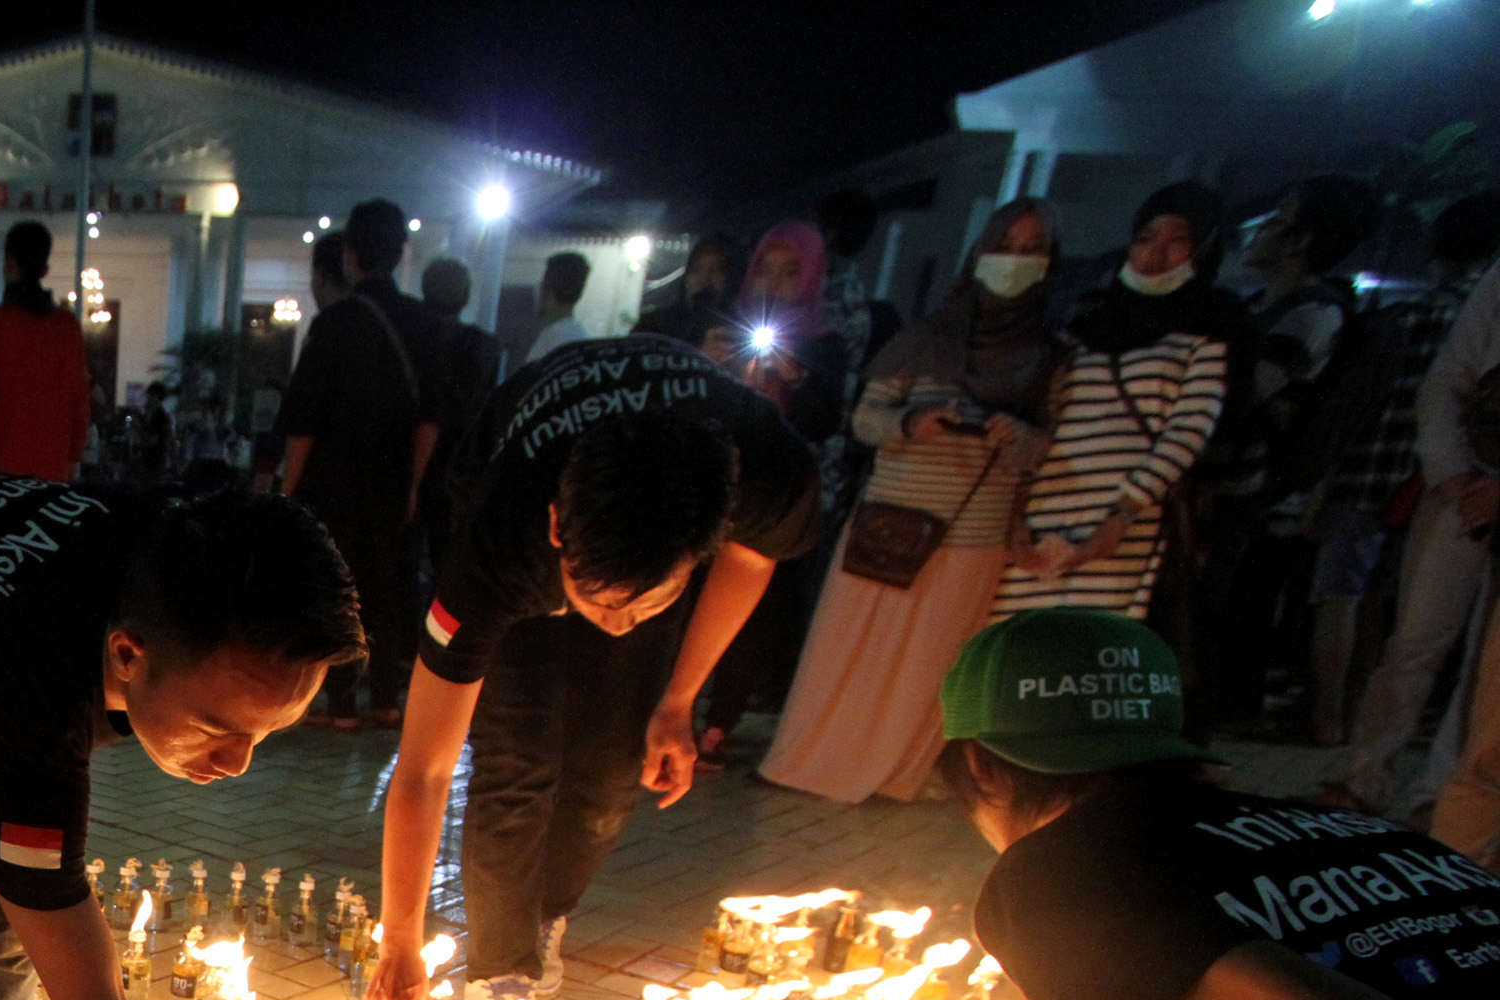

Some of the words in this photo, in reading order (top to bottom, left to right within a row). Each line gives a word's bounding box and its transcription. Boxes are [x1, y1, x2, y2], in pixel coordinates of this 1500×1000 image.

[37, 489, 111, 528] Ini
[1097, 646, 1141, 669] ON
[1017, 673, 1145, 699] PLASTIC
[1090, 698, 1153, 721] DIET
[1195, 805, 1302, 852] Ini
[1213, 873, 1412, 942] Mana
[1344, 911, 1465, 959] @EHBogor
